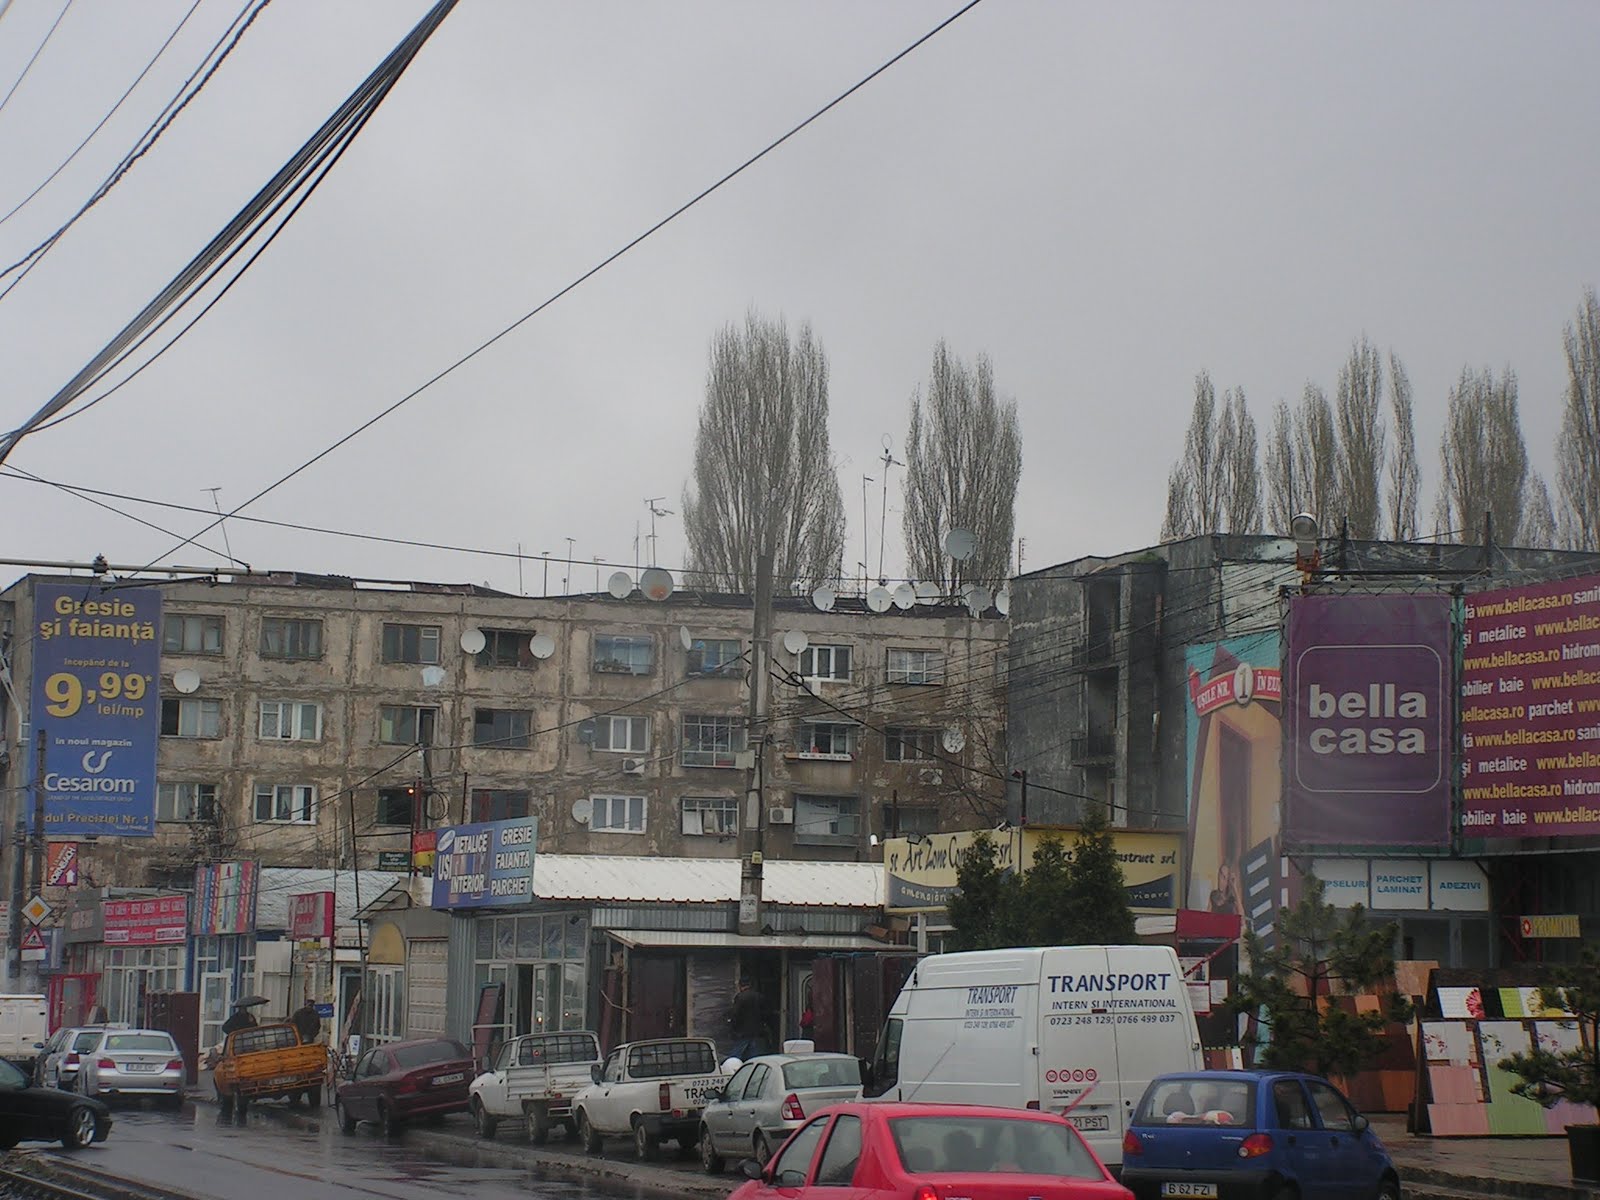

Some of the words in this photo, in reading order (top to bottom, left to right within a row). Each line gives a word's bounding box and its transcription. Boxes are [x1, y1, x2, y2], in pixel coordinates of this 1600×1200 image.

[55, 596, 136, 617] Gresie
[1477, 594, 1573, 618] www.bellacasa.ro
[1479, 624, 1527, 644] metalice
[1464, 648, 1560, 671] www.bellacasa.ro
[1239, 667, 1249, 699] 1
[1499, 677, 1525, 693] baie
[1309, 683, 1427, 718] bella
[1528, 699, 1574, 720] parchet
[98, 703, 144, 718] lei/mp
[91, 739, 133, 748] magazin
[1309, 727, 1426, 754] casa
[1475, 729, 1576, 748] www.bellacasa.ro
[1479, 756, 1528, 773] metalice
[43, 772, 136, 793] Cesarom
[1463, 783, 1562, 800] www.bellacasa.ro
[122, 814, 139, 824] Nr.
[143, 816, 149, 824] 1
[1502, 809, 1528, 825] baie
[453, 833, 488, 855] METALICE
[501, 826, 533, 846] GRESIE
[438, 853, 453, 881] USI
[495, 851, 531, 870] FAIANTA
[902, 841, 923, 873] Art
[1160, 850, 1176, 865] srl
[450, 873, 485, 894] INTERIOR
[490, 876, 531, 897] PARCHET
[1376, 875, 1423, 884] PARCHET
[1439, 881, 1481, 890] ADEZIVI
[1377, 886, 1422, 894] LAMINAT
[1047, 973, 1171, 992] TRANSPORT
[967, 986, 1018, 1004] TRANSPORT
[1052, 1001, 1088, 1010] INTERN
[1102, 999, 1177, 1008] INTERNATIONAL
[1050, 1017, 1072, 1025] 0723
[1075, 1016, 1092, 1024] 248
[1159, 1014, 1175, 1022] 037
[684, 1086, 726, 1100] TRA
[1084, 1118, 1103, 1128] PST
